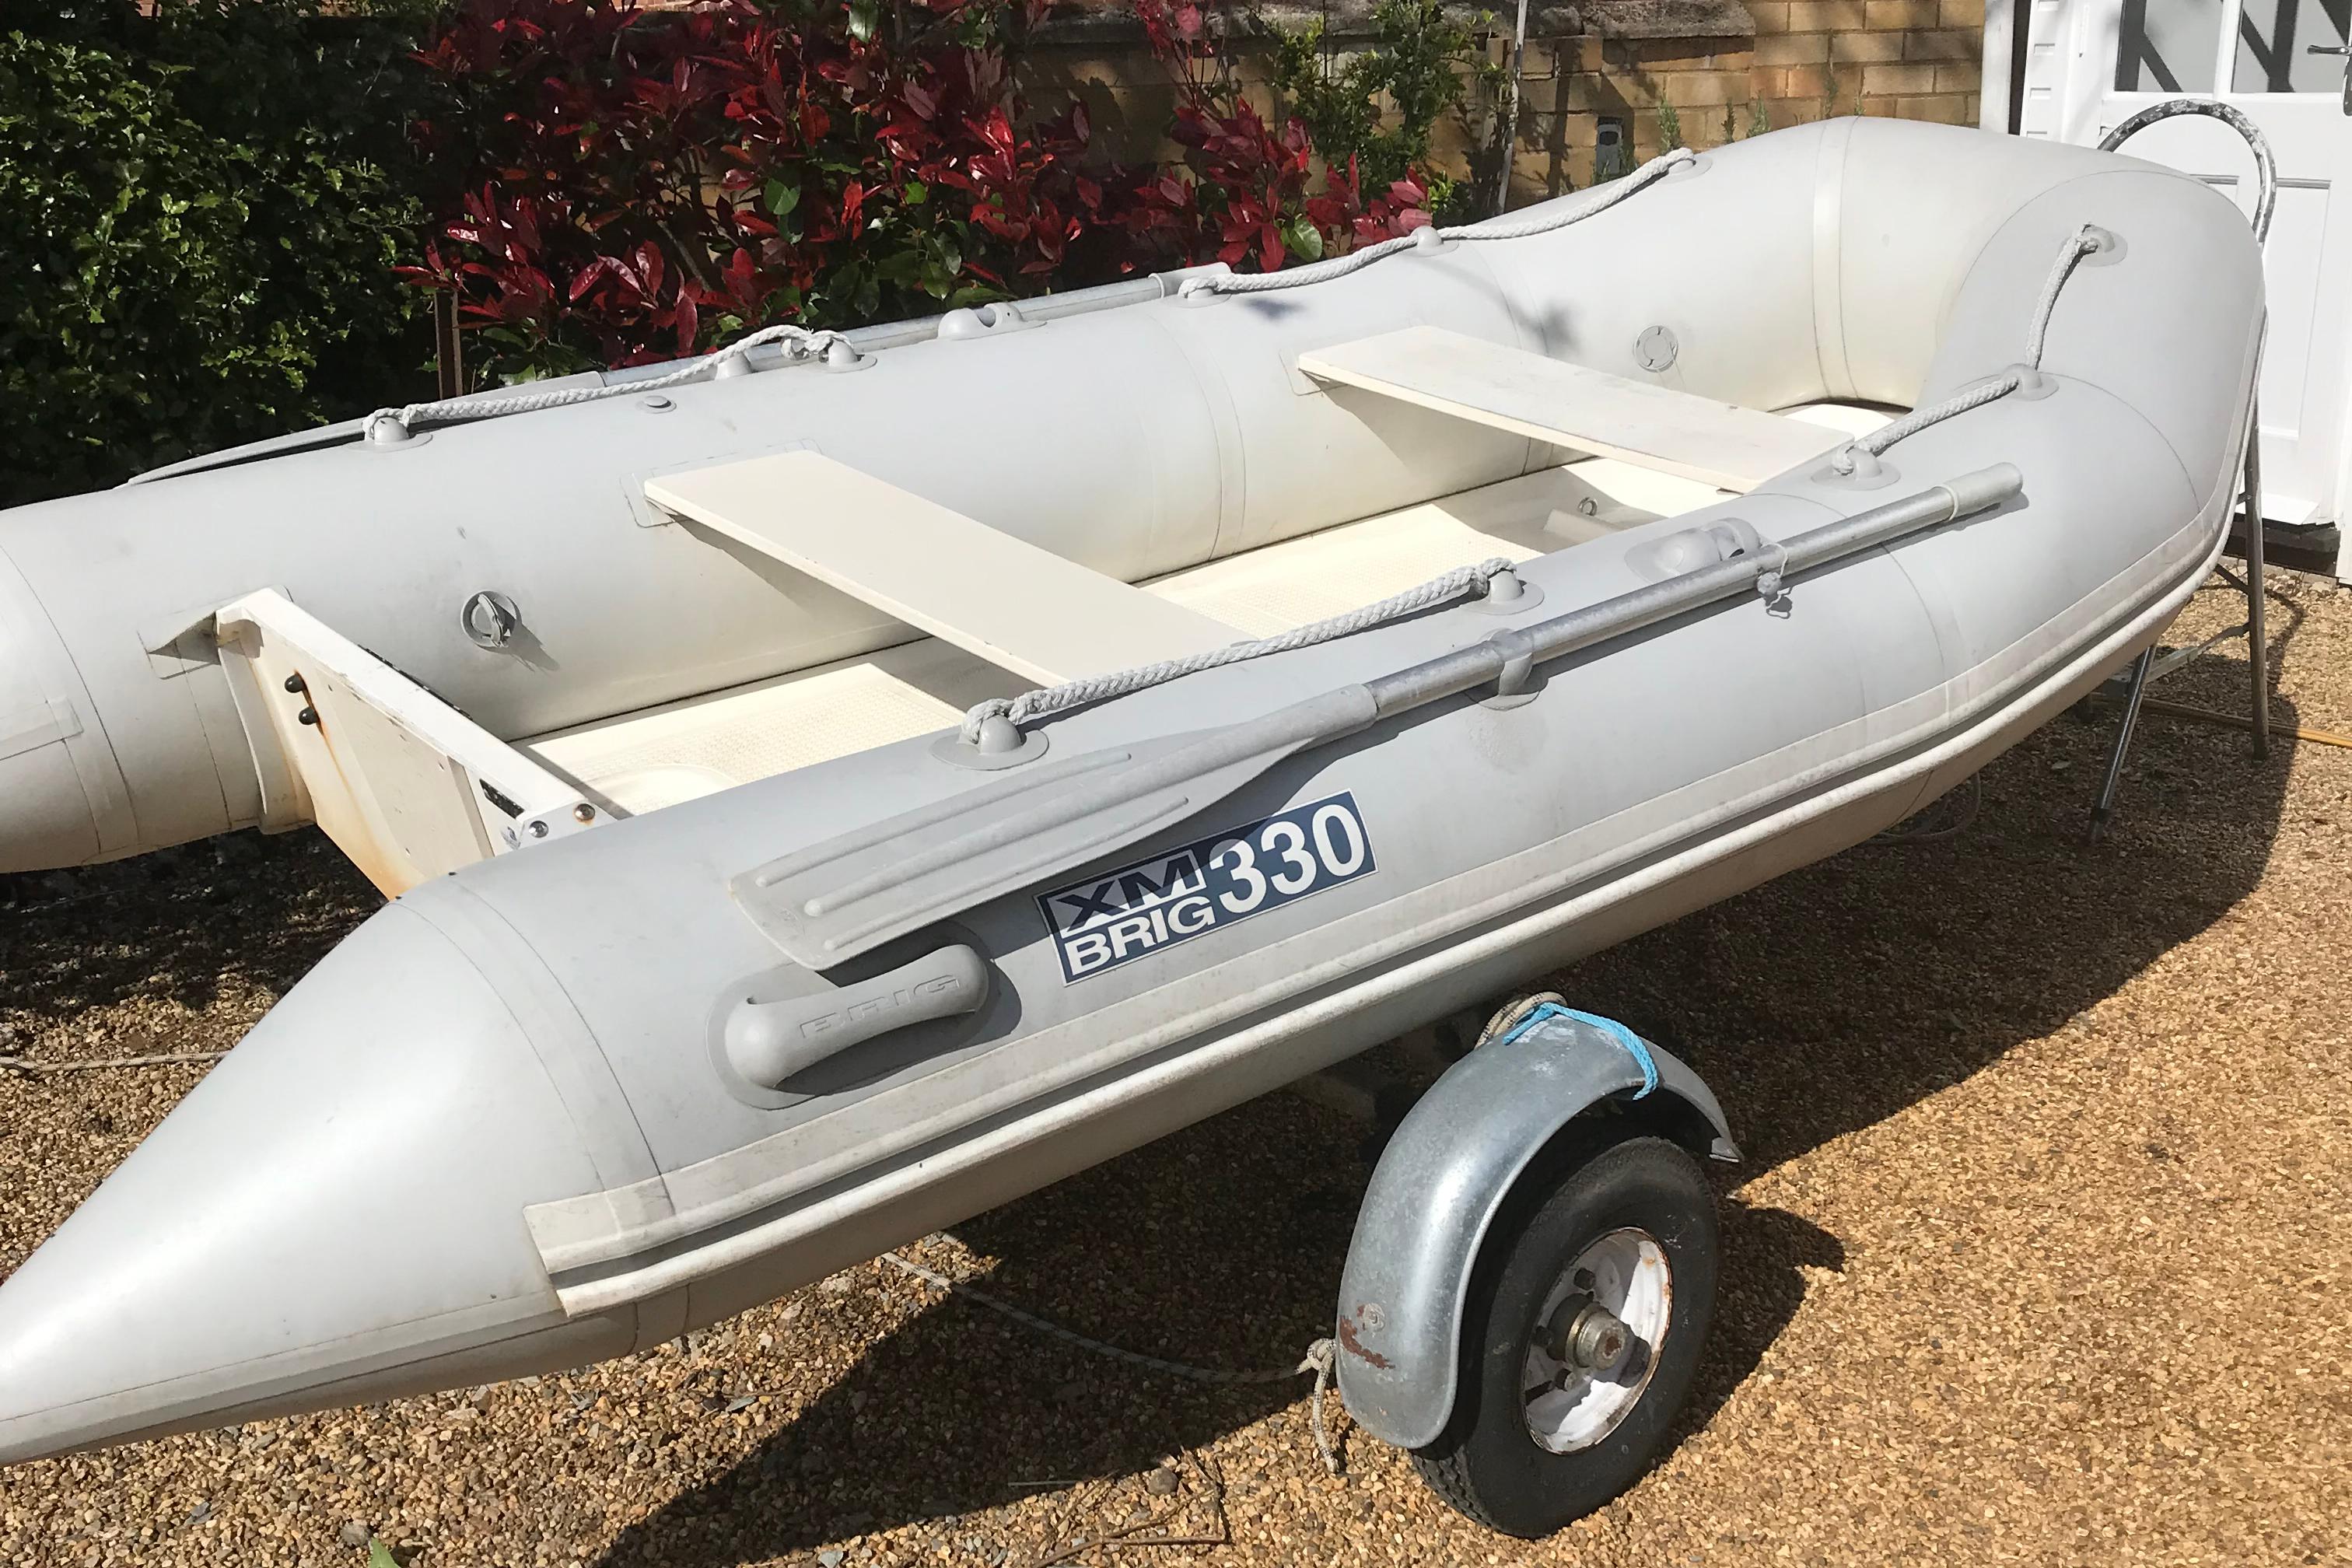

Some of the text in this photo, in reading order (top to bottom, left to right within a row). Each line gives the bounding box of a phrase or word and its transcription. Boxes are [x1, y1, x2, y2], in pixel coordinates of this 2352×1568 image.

[1056, 859, 1200, 932] XM
[1209, 804, 1365, 913] 330
[1065, 897, 1216, 976] BRIG
[799, 975, 961, 1038] BRIG
